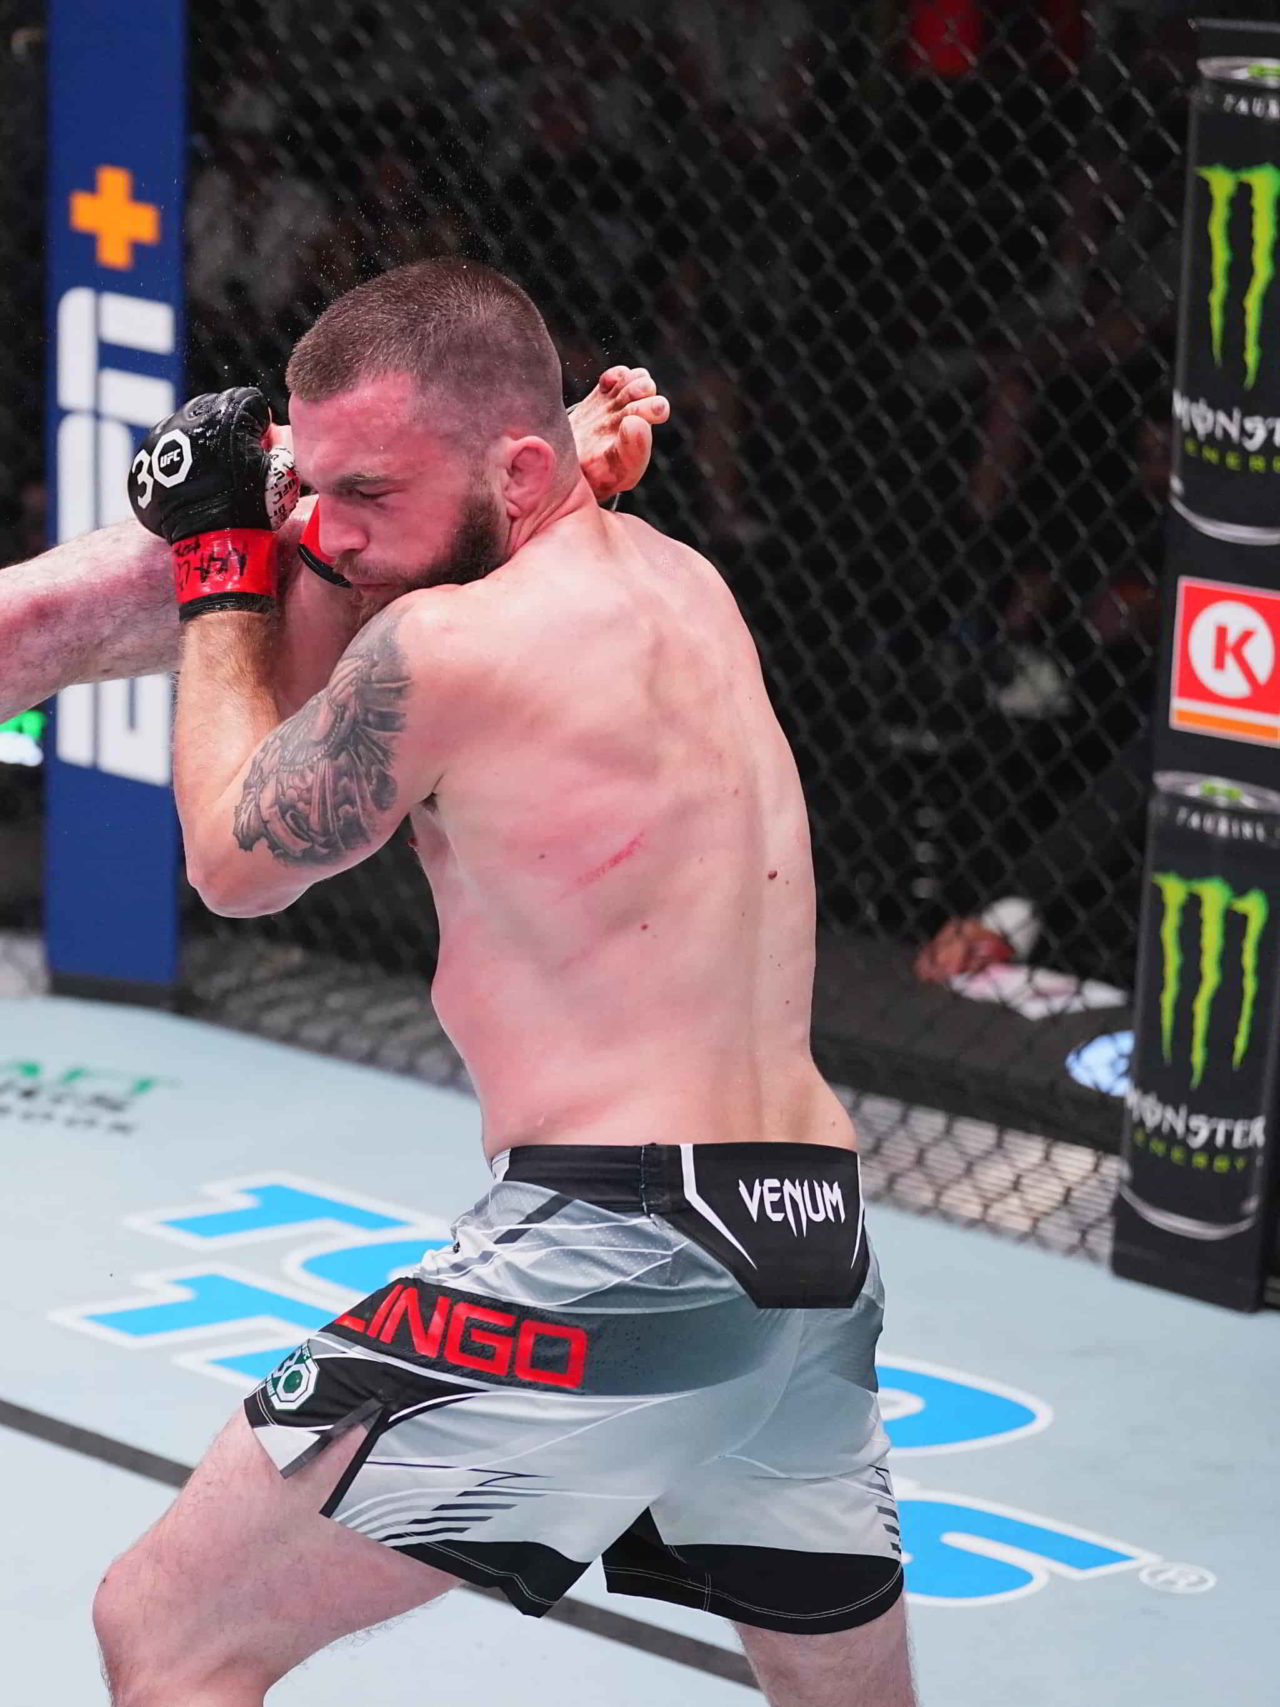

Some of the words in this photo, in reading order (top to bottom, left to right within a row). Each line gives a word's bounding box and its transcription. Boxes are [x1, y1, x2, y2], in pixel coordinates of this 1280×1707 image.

[131, 429, 193, 510] 30
[160, 448, 181, 468] UFC
[738, 1178, 846, 1238] VENUM
